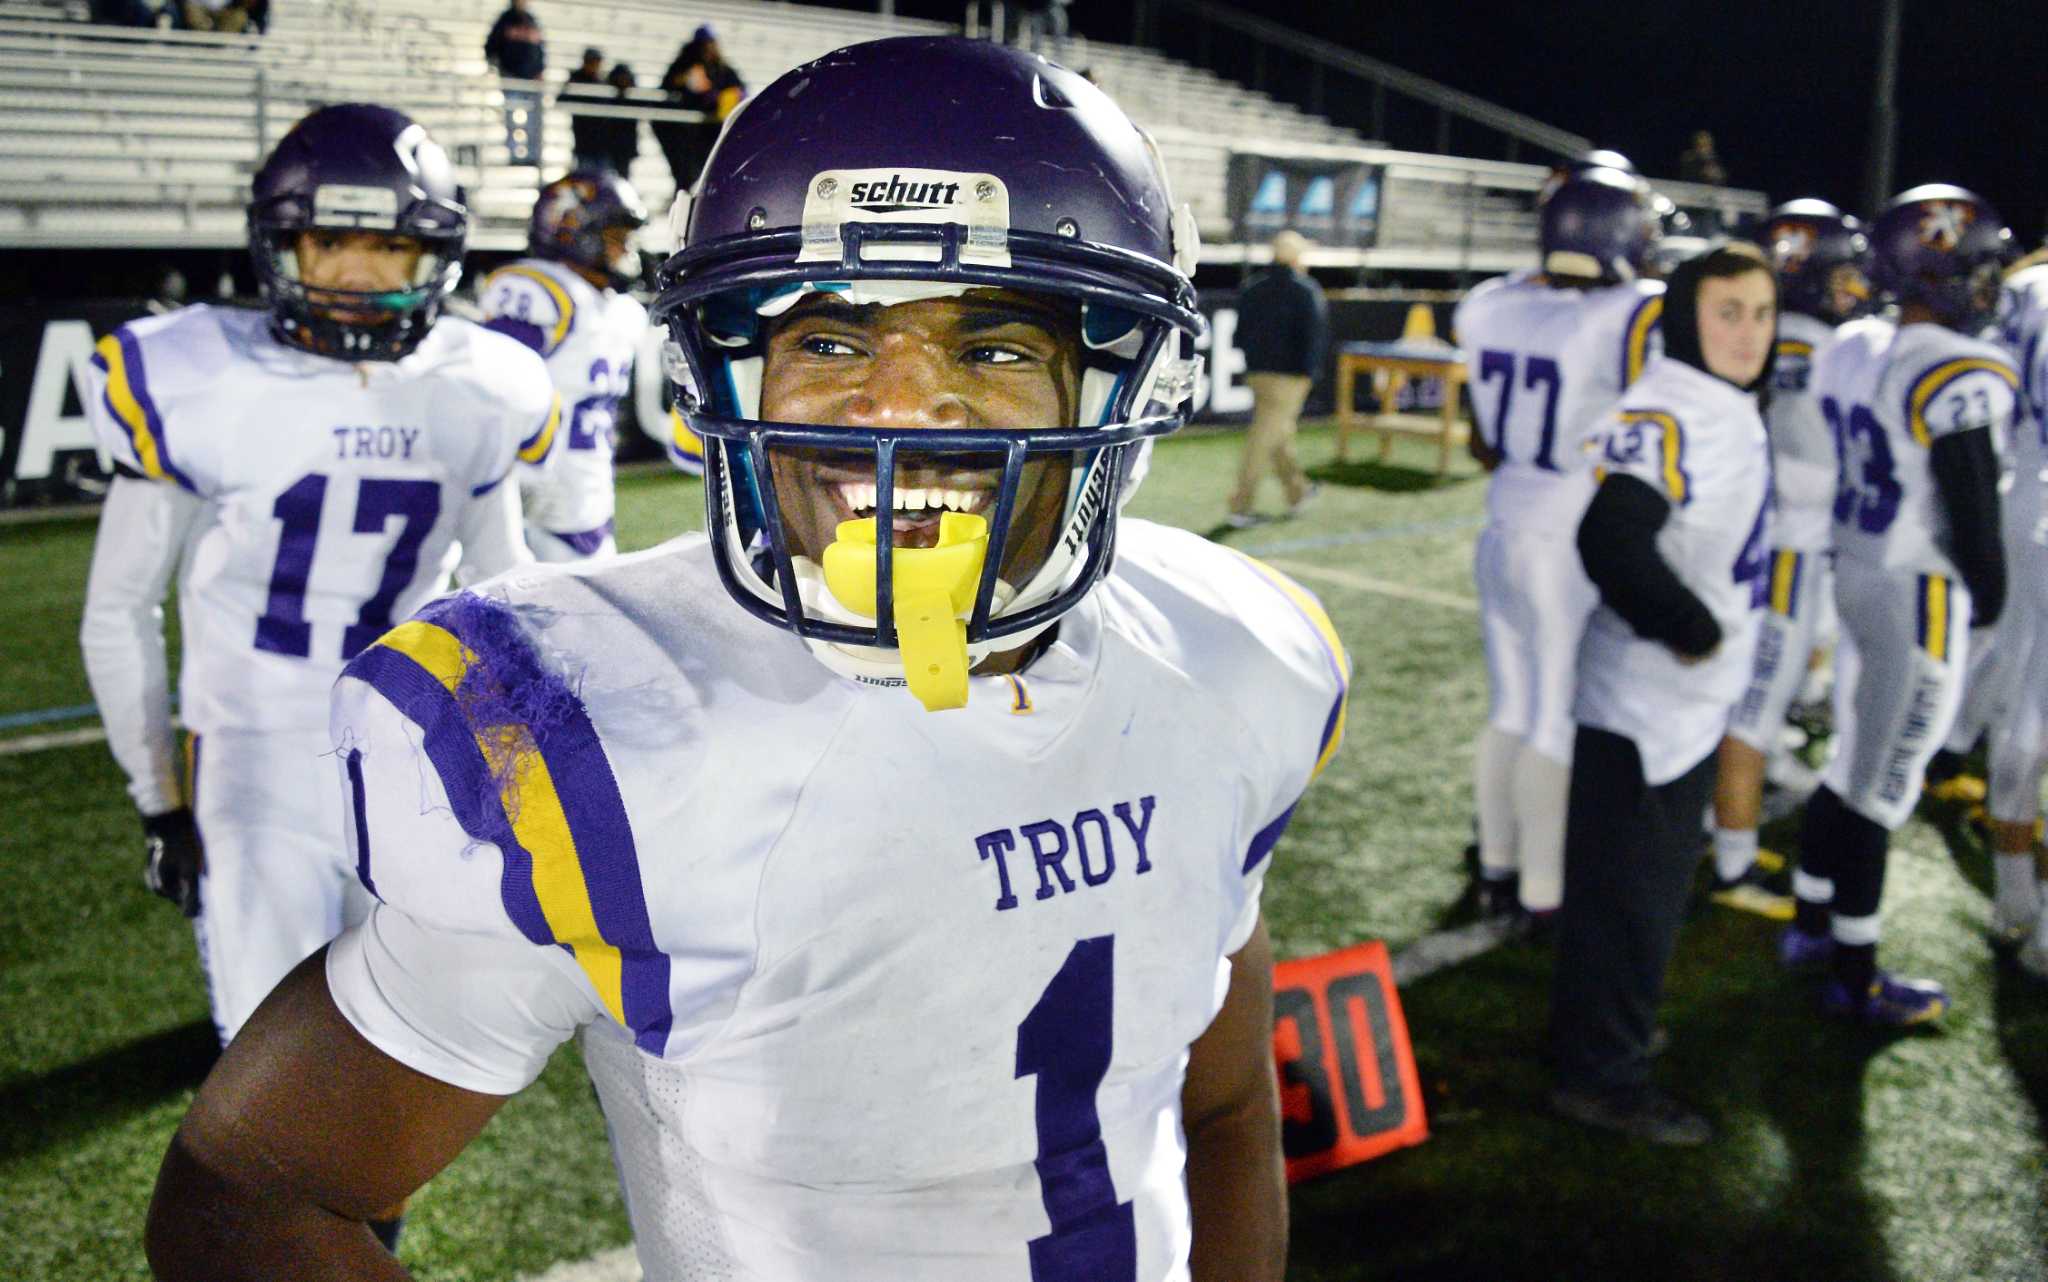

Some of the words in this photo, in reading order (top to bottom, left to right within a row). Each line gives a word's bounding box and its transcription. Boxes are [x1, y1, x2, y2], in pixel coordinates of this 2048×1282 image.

[850, 174, 960, 205] schutt
[333, 426, 420, 459] TROY
[1479, 348, 1567, 474] 77
[254, 472, 442, 660] 17
[975, 795, 1156, 912] TROY
[1014, 933, 1137, 1282] 1
[1273, 971, 1407, 1158] 30
